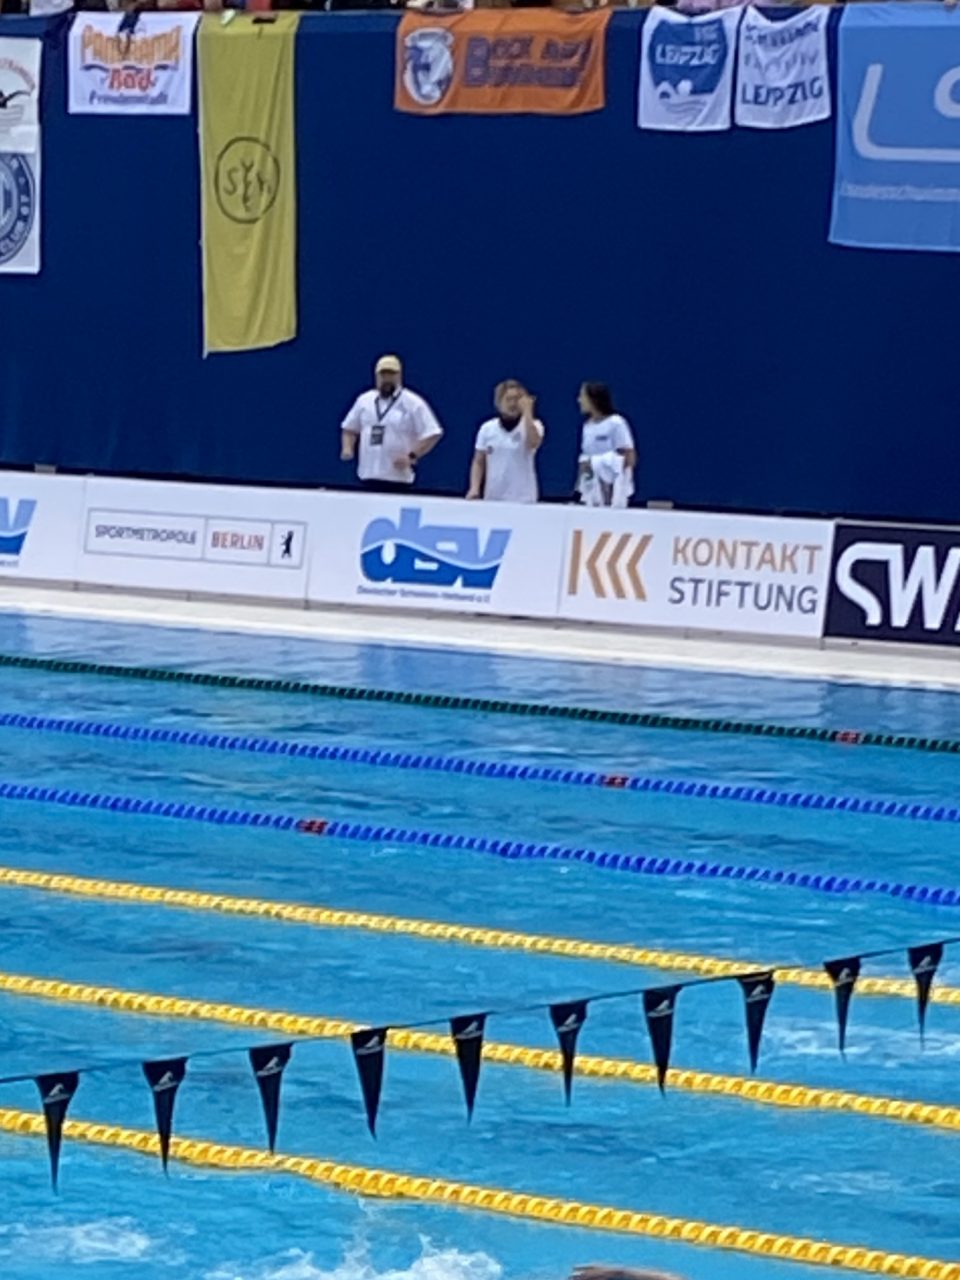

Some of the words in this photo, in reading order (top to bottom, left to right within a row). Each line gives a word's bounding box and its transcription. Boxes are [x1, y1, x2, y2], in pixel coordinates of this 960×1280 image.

[655, 44, 721, 67] LEIPZIG
[741, 76, 824, 106] LEIPZIG
[94, 524, 198, 546] SPORTMETROPOLE
[211, 531, 265, 551] BERLIN
[672, 535, 822, 575] KONTAKT
[668, 576, 818, 615] STIFTUNG
[835, 541, 960, 632] SW
